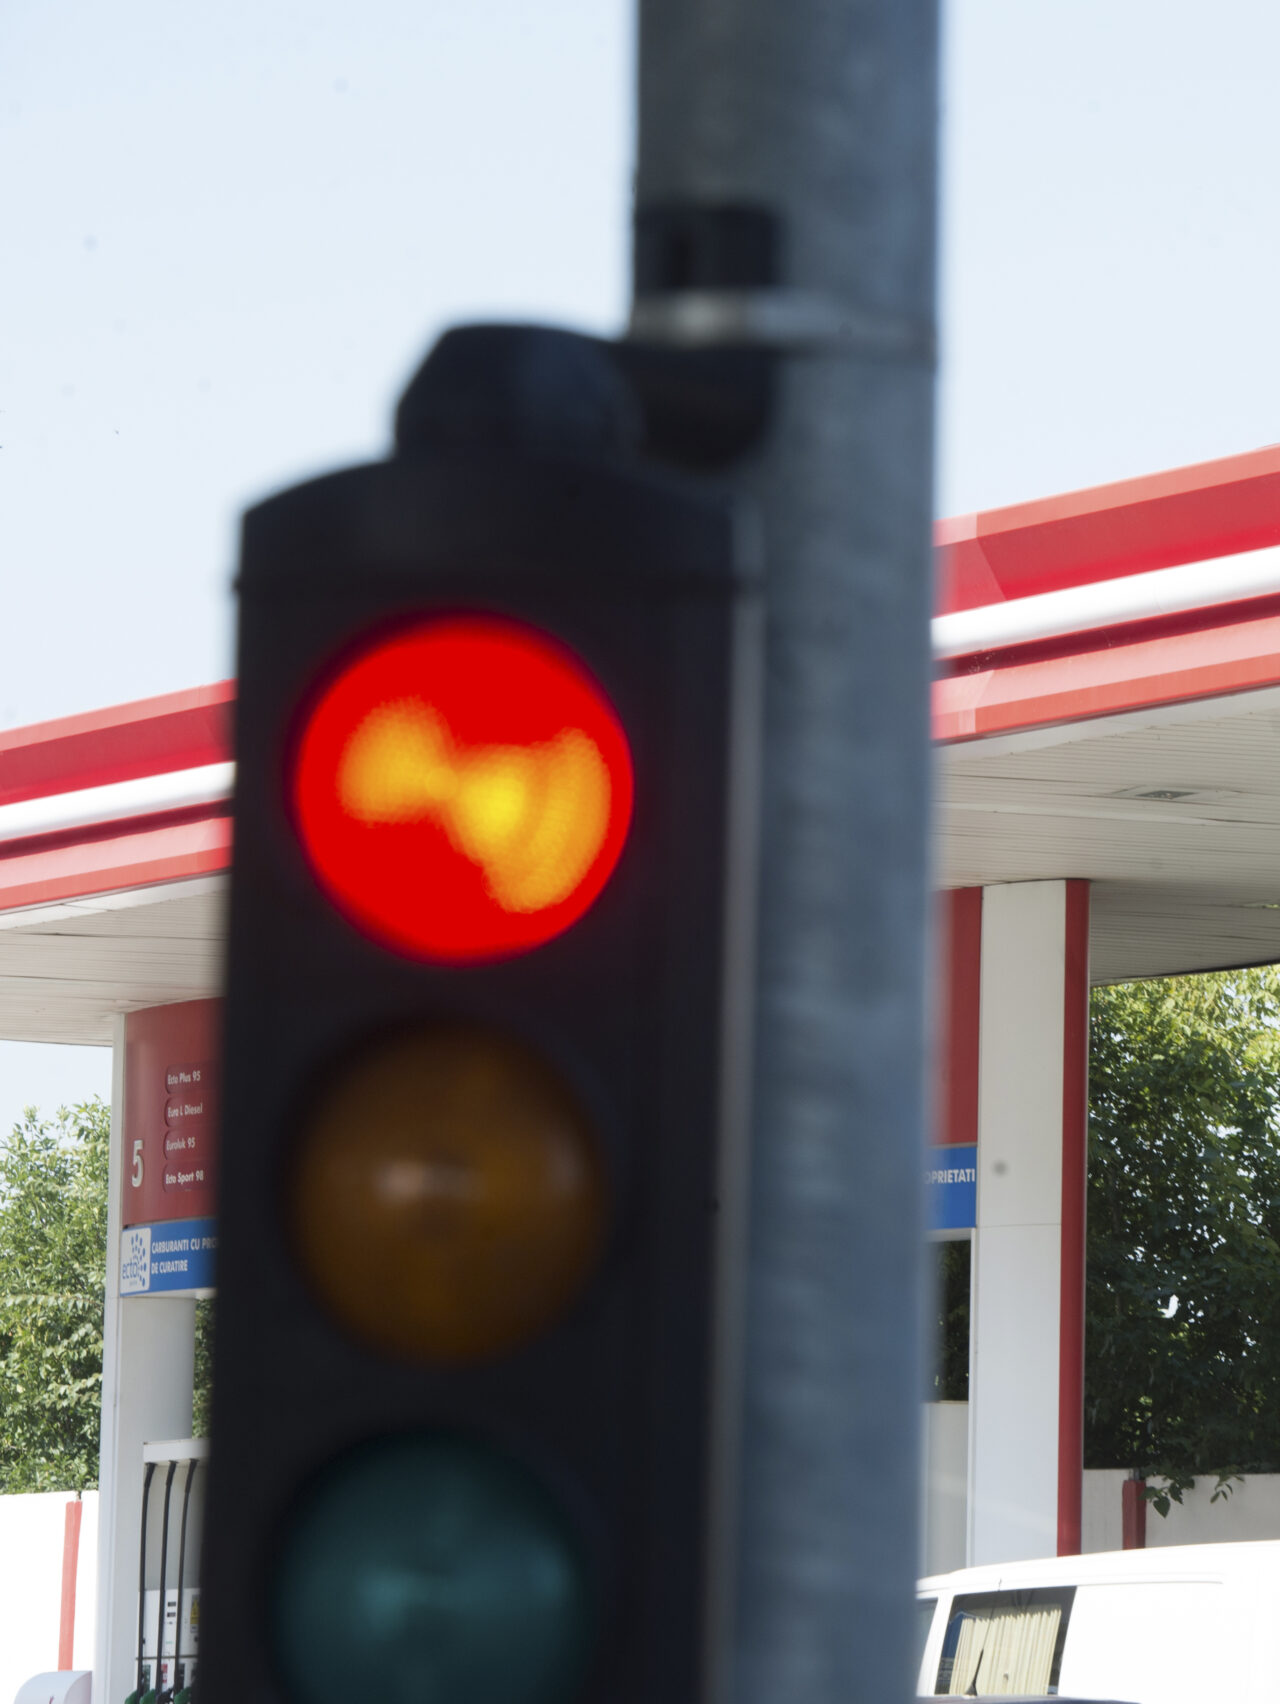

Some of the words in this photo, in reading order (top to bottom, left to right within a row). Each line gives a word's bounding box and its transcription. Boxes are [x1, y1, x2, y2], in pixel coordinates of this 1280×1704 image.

[168, 1074, 178, 1085] Ecto
[179, 1072, 191, 1083] Plus
[192, 1070, 201, 1082] 95
[184, 1103, 203, 1115] Diesel
[187, 1137, 196, 1149] 95
[131, 1139, 145, 1188] 5
[166, 1174, 176, 1185] Ecto
[177, 1171, 195, 1184] Sport
[195, 1170, 204, 1181] 98
[152, 1240, 189, 1254] CARBURANTI
[191, 1239, 200, 1250] CU
[151, 1262, 158, 1274] DE
[160, 1260, 188, 1273] CURATIRE
